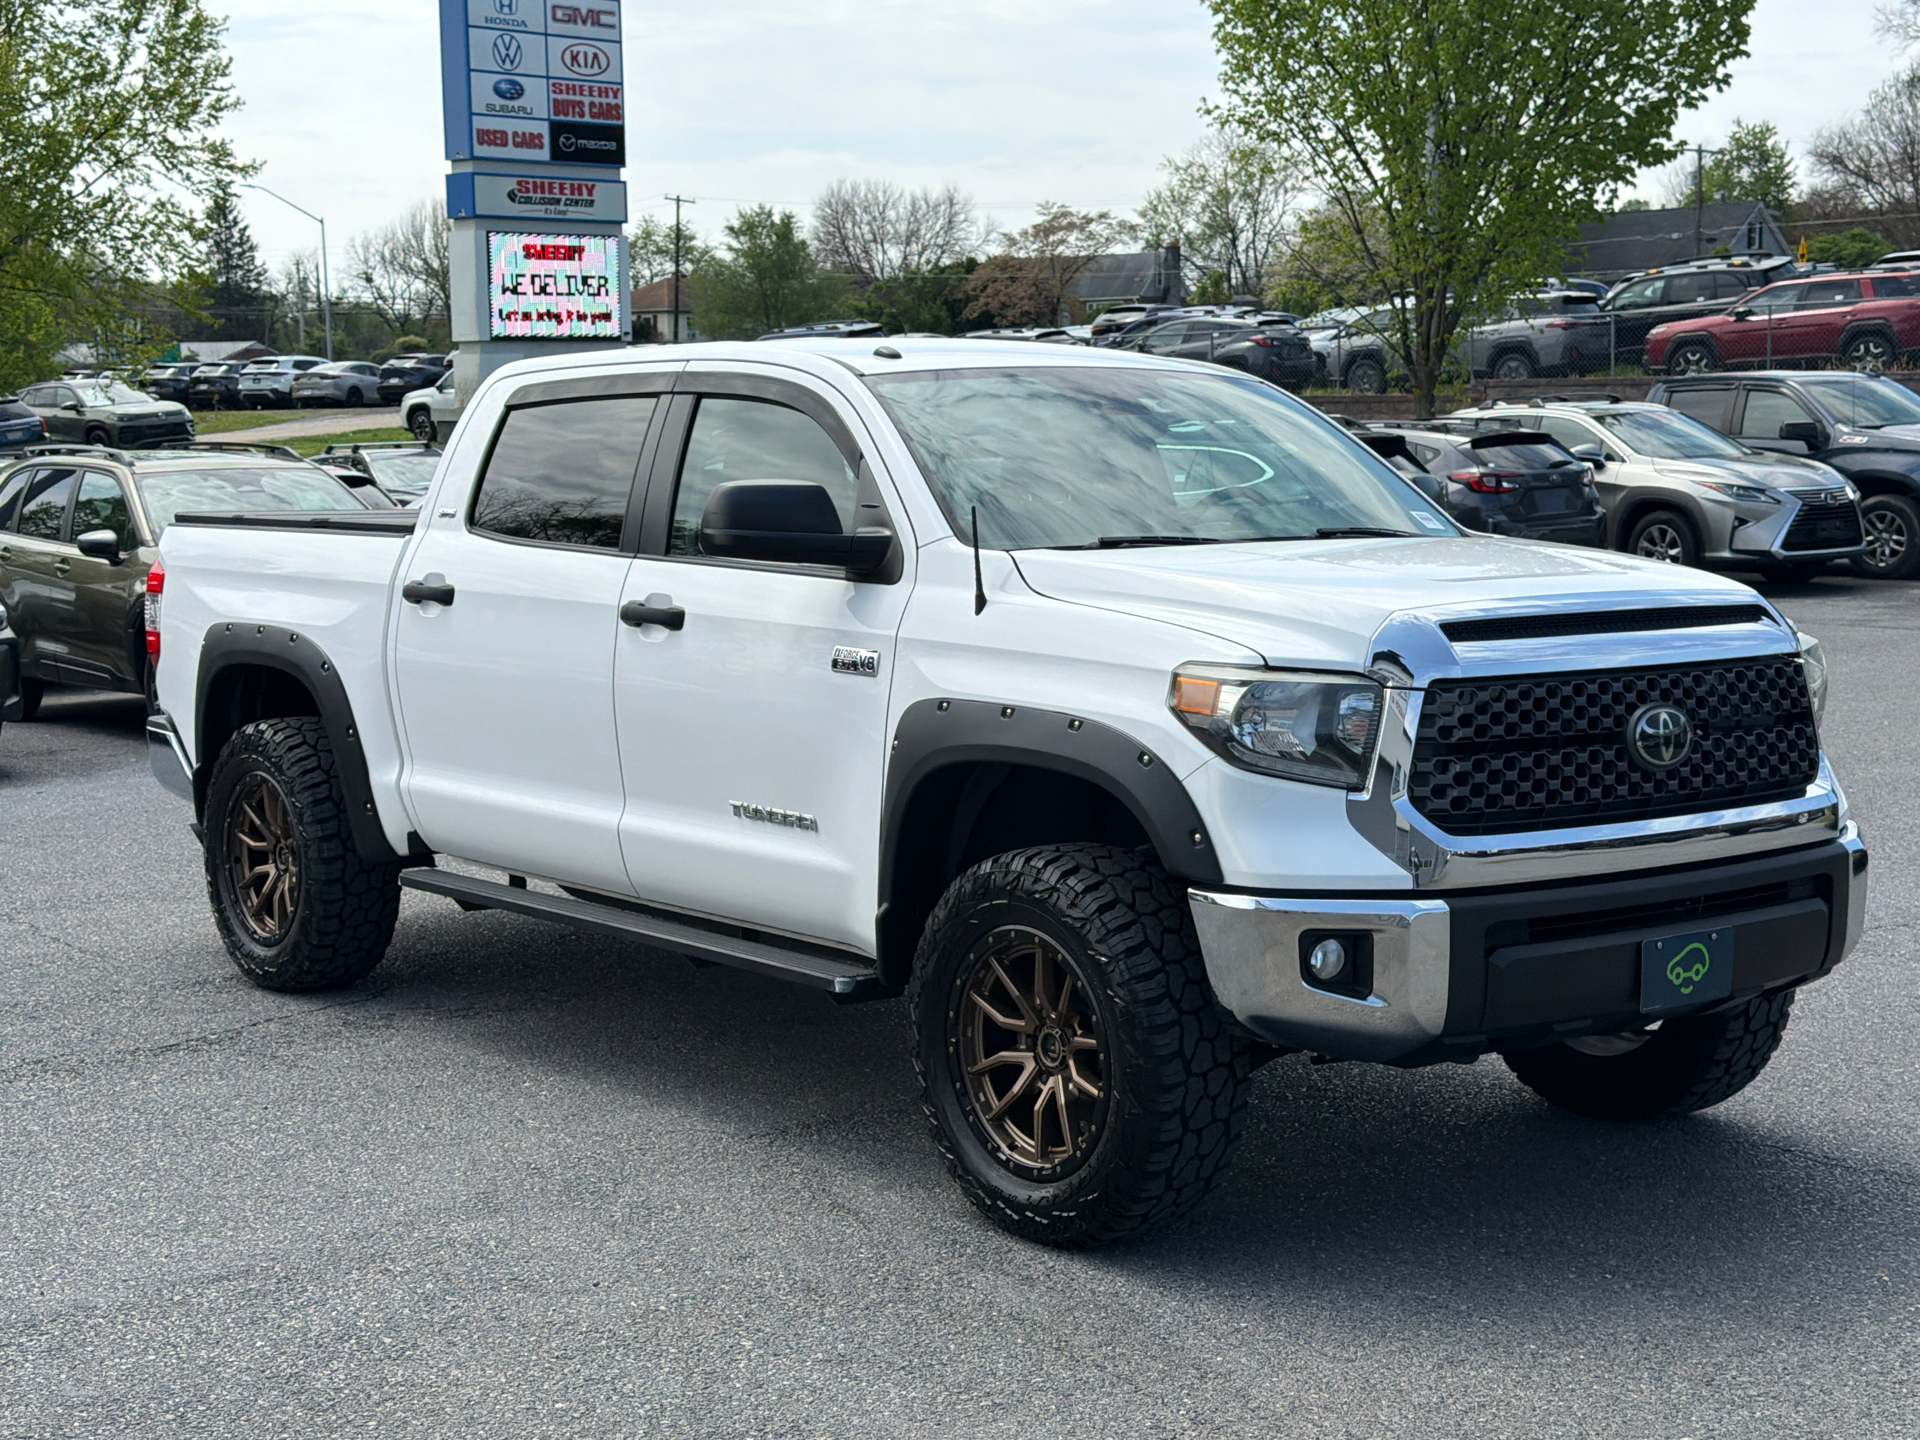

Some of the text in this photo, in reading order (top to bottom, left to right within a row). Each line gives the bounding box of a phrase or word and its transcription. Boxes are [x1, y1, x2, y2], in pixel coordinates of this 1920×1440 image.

[484, 16, 529, 28] HONDA
[552, 5, 617, 29] GMC
[570, 49, 603, 70] KIA
[551, 82, 621, 99] SHEEHY
[485, 102, 534, 115] SUBARU
[552, 98, 622, 121] BUYS CARS
[475, 128, 545, 150] USED CARS
[577, 139, 617, 151] mazda
[515, 179, 597, 197] SHEEHY
[517, 195, 596, 209] COLLISION CENTER
[523, 244, 585, 261] SHEEHY
[501, 273, 609, 297] WE DELIVER
[859, 654, 876, 672] V8
